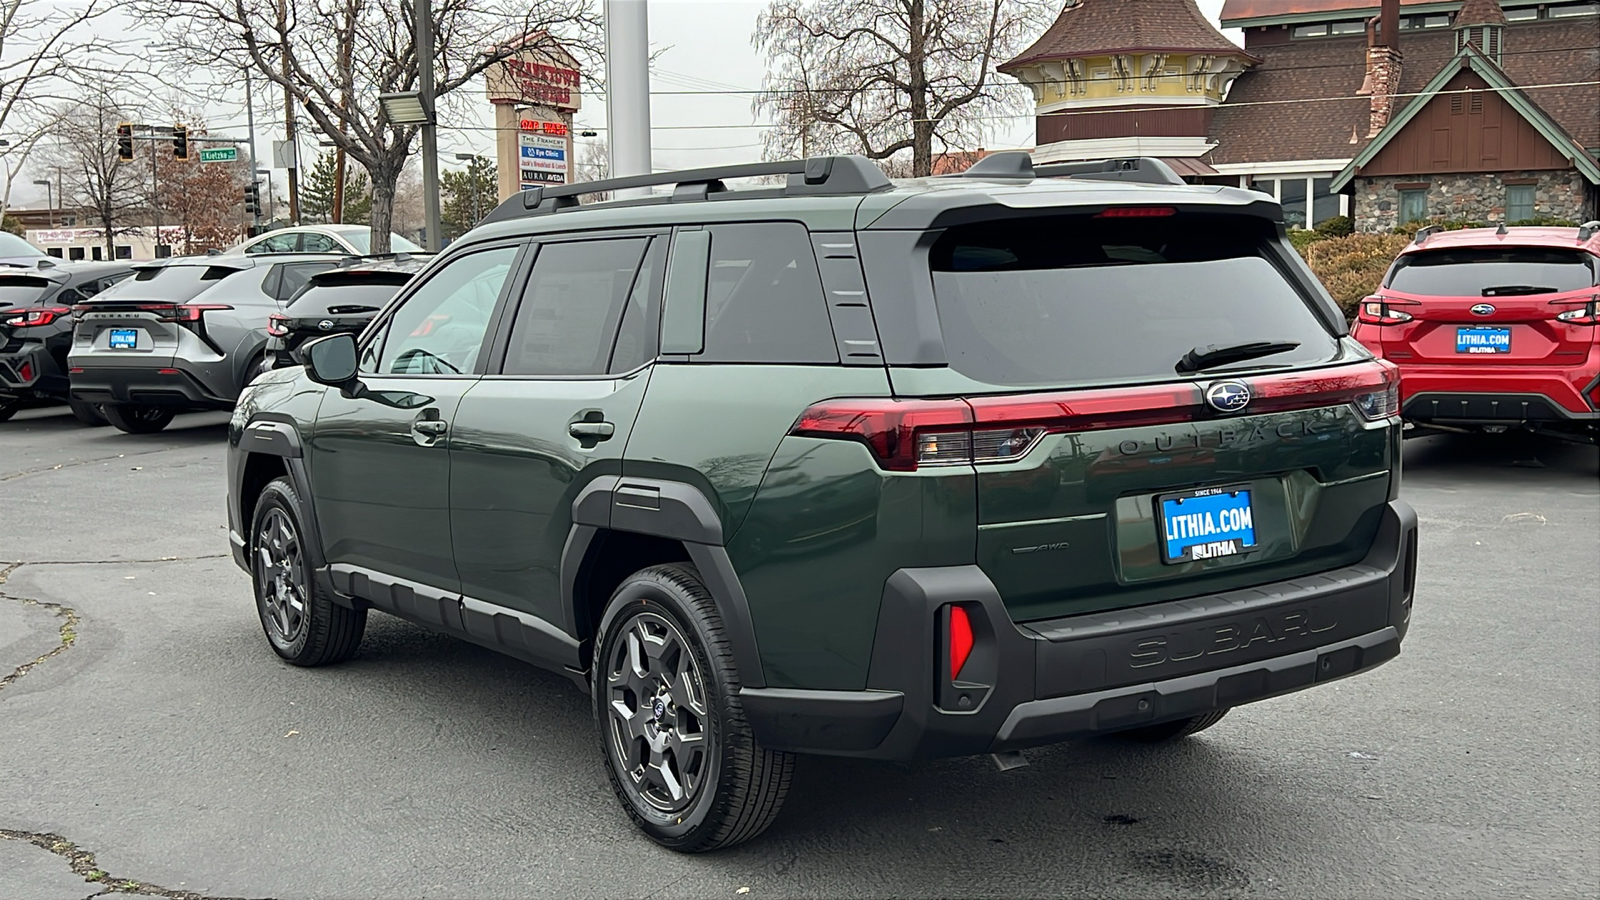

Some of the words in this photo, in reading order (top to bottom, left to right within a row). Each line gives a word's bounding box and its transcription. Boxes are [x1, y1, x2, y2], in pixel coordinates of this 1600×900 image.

[520, 119, 539, 132] CAR
[536, 149, 545, 157] Eye
[545, 150, 559, 158] Clinic
[522, 171, 544, 180] AURA
[547, 174, 564, 182] AVEDA
[1457, 334, 1510, 345] LITHIA.COM
[1118, 418, 1318, 456] OUTBACK
[1194, 489, 1210, 497] SINCE
[1165, 506, 1253, 541] LITHIA.COM
[1202, 540, 1237, 559] LITHIA
[1130, 606, 1339, 669] SUBARU
